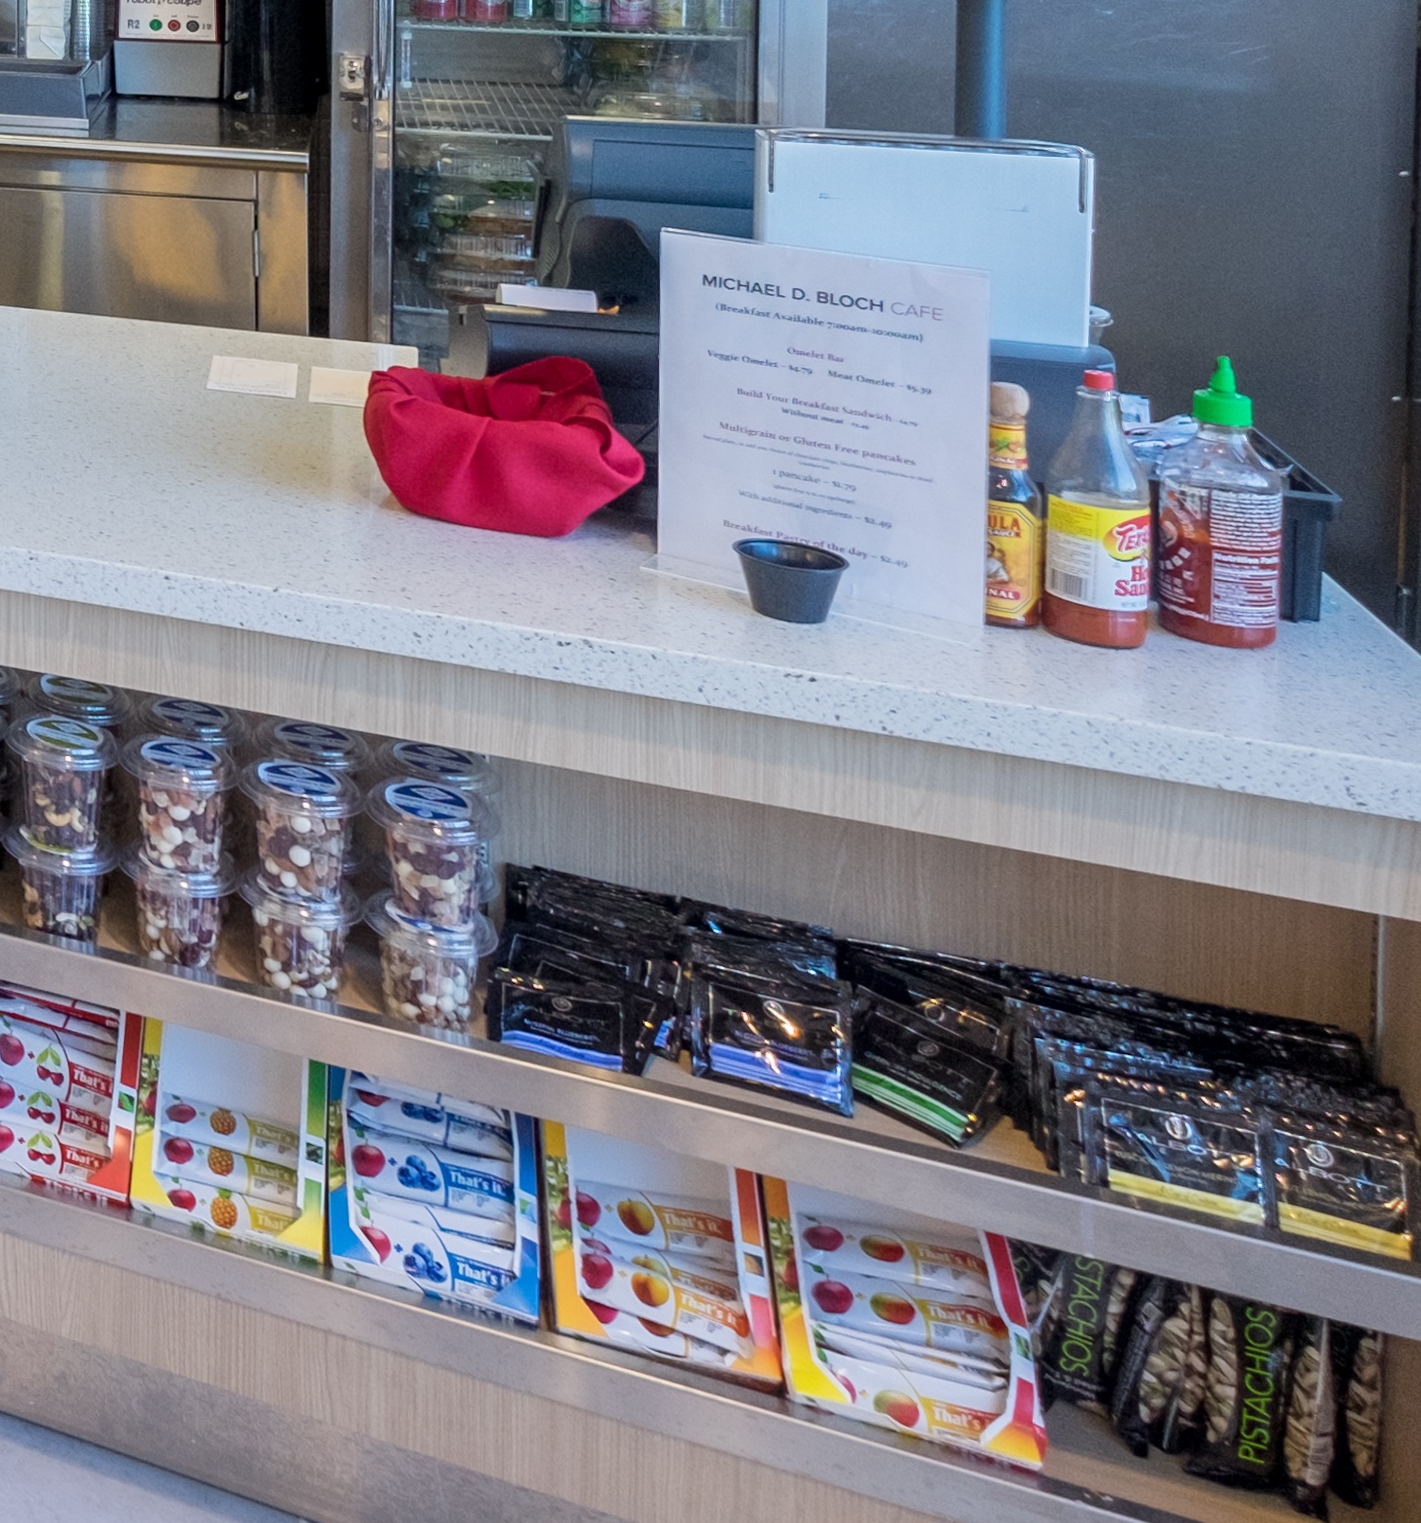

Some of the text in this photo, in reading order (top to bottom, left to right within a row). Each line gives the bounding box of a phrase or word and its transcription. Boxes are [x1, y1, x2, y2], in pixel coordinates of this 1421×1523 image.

[127, 19, 140, 29] R2
[702, 274, 945, 322] MICHAEL D. BLOCH CAFE
[715, 302, 771, 319] (Breakfast
[773, 312, 825, 328] Available
[787, 346, 845, 363] Omelet Bar
[707, 349, 740, 363] Veggie
[741, 355, 779, 369] Omelet
[827, 369, 854, 382] Meat
[855, 374, 895, 389] Omelet
[736, 387, 892, 423] Build Your Breakfast Sandwich
[781, 407, 844, 425] Without meat
[719, 421, 916, 467] Multigrain or Gluten Free pancakes
[778, 470, 821, 485] pancake
[738, 489, 760, 501] With
[761, 494, 804, 510] additional
[805, 503, 854, 520] ingredients
[723, 519, 774, 538] Breakfast
[775, 530, 812, 548] Pastry
[813, 537, 825, 549] of
[826, 542, 846, 554] the
[848, 546, 868, 561] day
[1213, 552, 1259, 564] Nutrition
[74, 1067, 109, 1090] That's
[65, 1107, 99, 1128] That's
[66, 1148, 100, 1168] That's
[450, 1170, 491, 1191] That's
[663, 1211, 704, 1231] That's
[918, 1245, 961, 1268] That's
[457, 1263, 498, 1284] That's
[680, 1290, 720, 1314] That's
[927, 1305, 971, 1325] That's
[1059, 1255, 1105, 1377] STACHIOS
[1237, 1305, 1278, 1465] PISTACHIOS
[933, 1406, 983, 1432] That's
